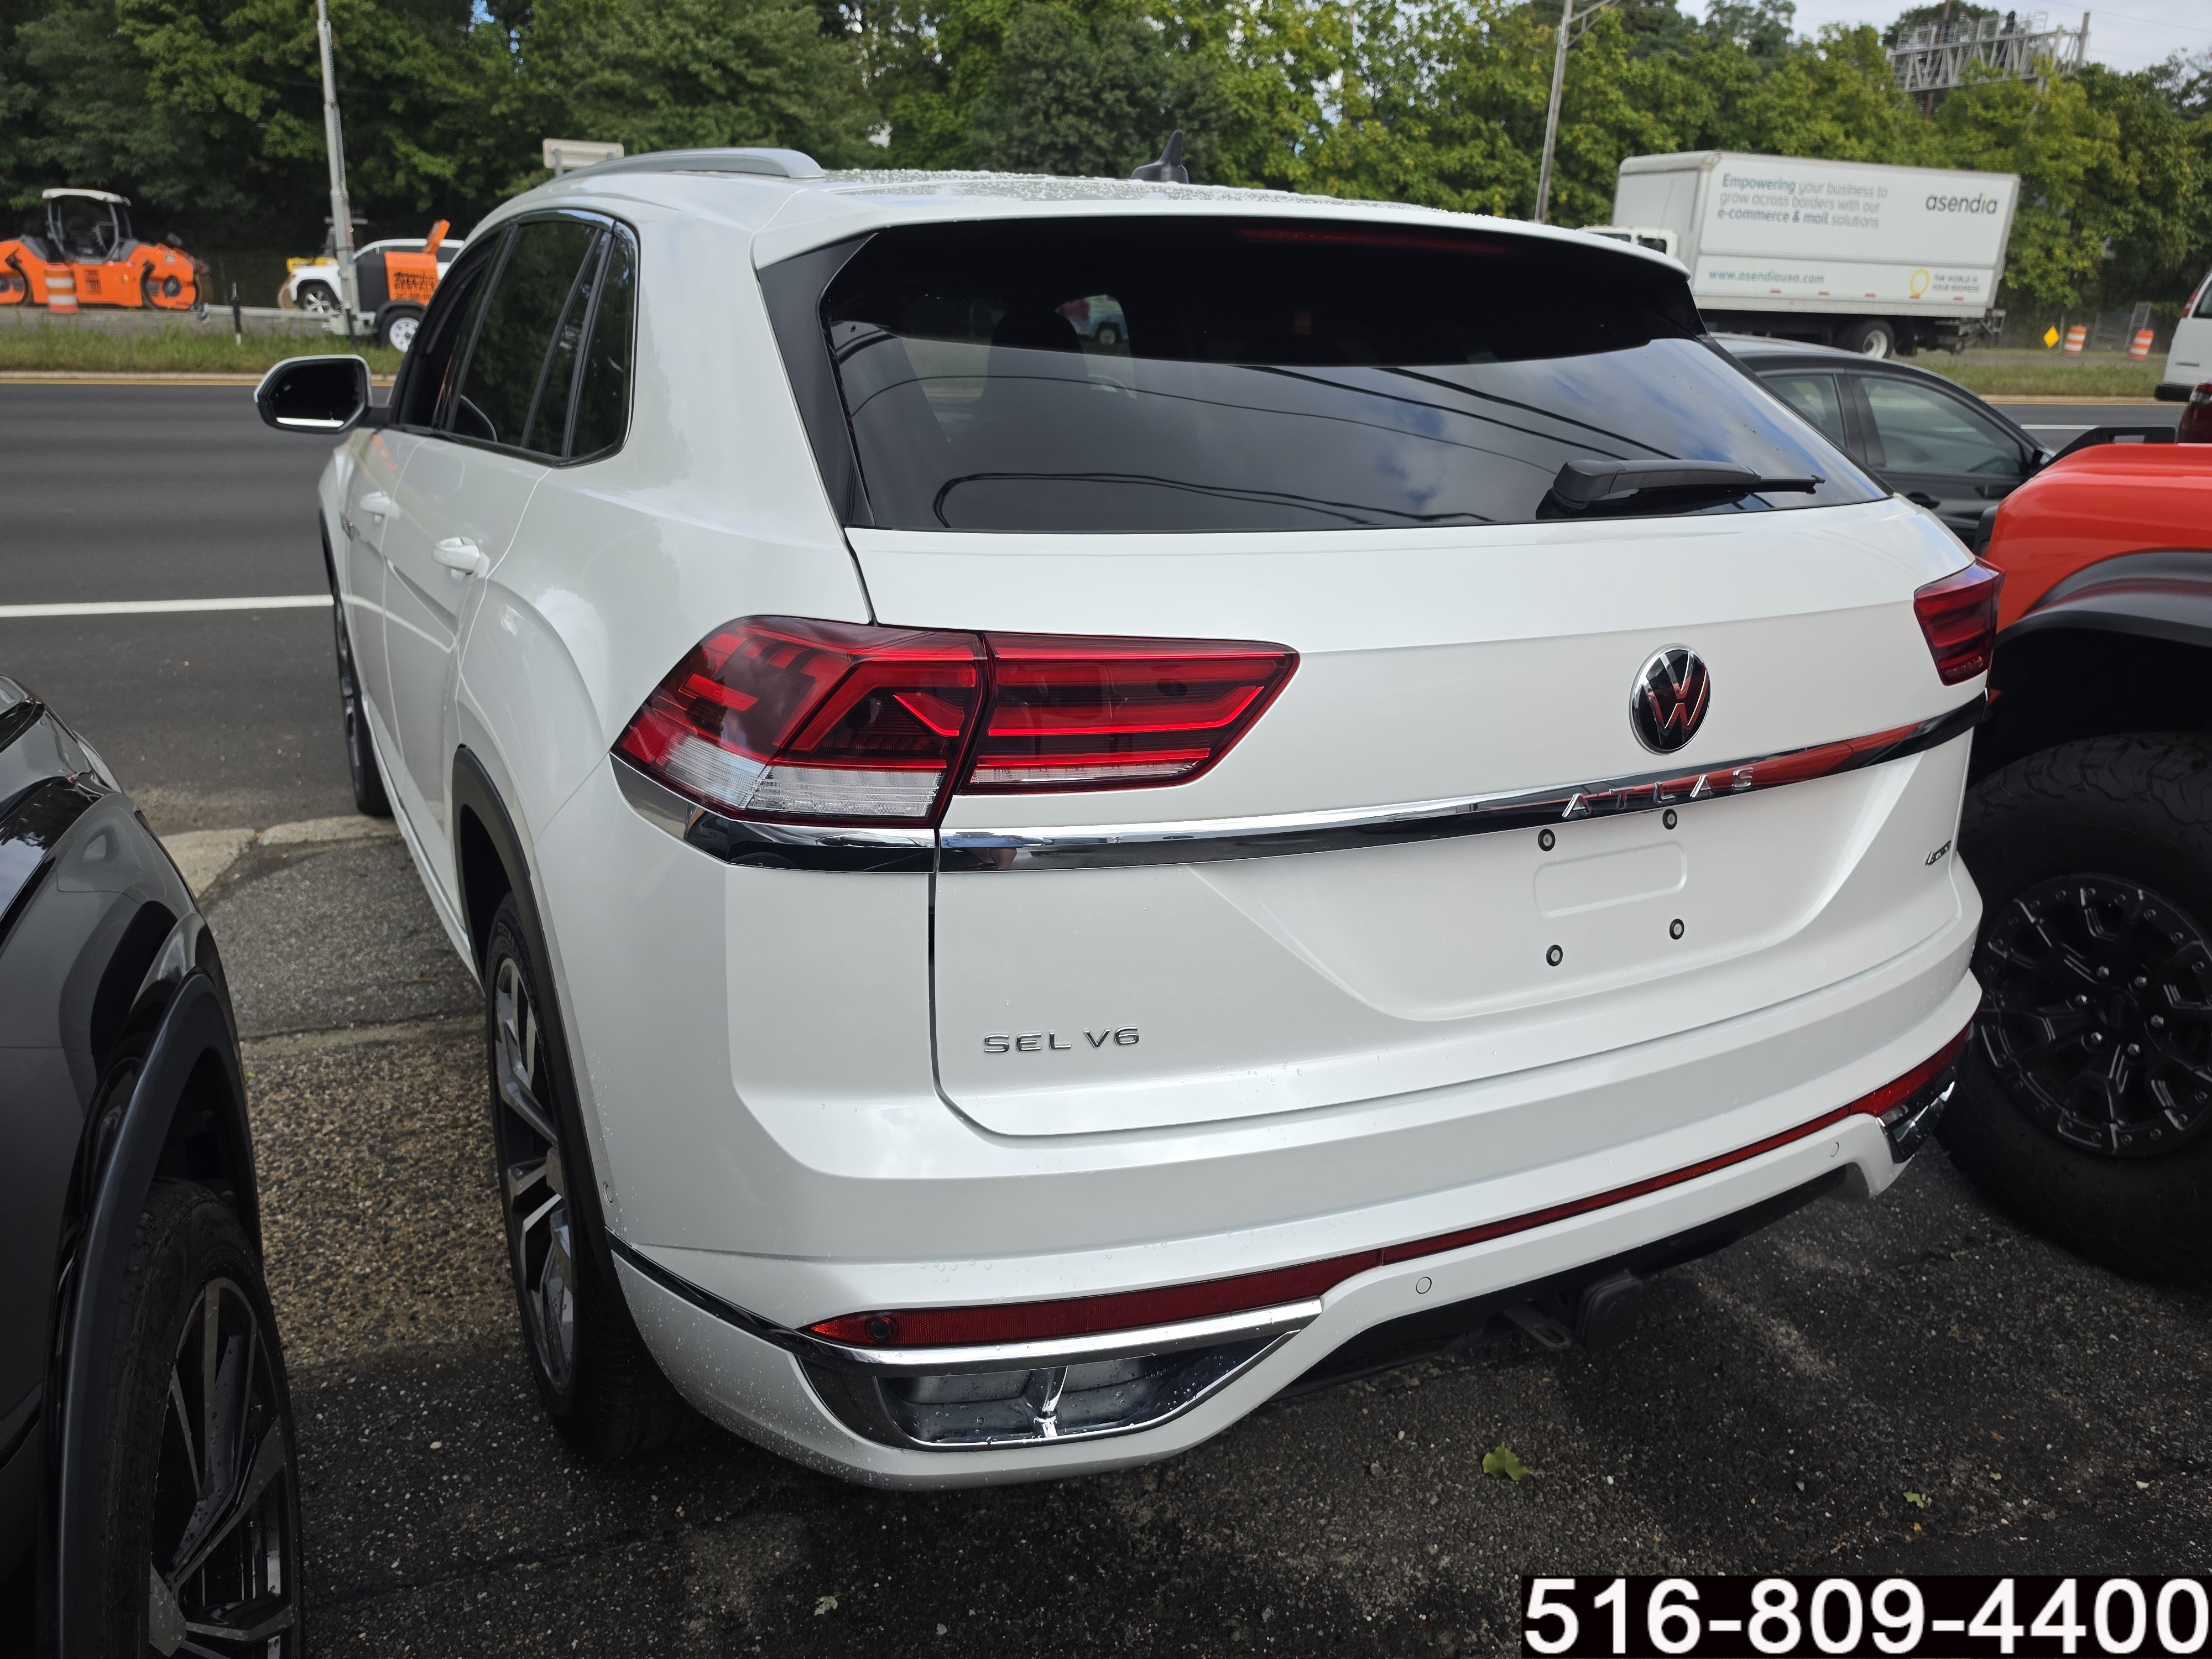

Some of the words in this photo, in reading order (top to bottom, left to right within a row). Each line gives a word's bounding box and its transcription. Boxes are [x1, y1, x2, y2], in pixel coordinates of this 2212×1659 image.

[1722, 173, 1796, 194] Empowering
[1798, 181, 1825, 196] your
[1827, 181, 1874, 198] business
[1877, 186, 1888, 199] to
[1719, 192, 1750, 207] grow
[1752, 194, 1790, 207] across
[1792, 195, 1834, 210] borders
[1838, 199, 1860, 212] with
[1862, 201, 1881, 213] our
[1926, 191, 1998, 215] asendia
[1718, 208, 1790, 223] e-commerce
[1792, 209, 1800, 223] &
[1803, 211, 1829, 226] mail
[1831, 213, 1880, 229] solutions
[1709, 269, 1824, 285] www.asendiausa.com
[1562, 766, 1754, 818] ATLAS
[984, 1031, 1072, 1053] SEL
[1083, 1025, 1140, 1048] V6
